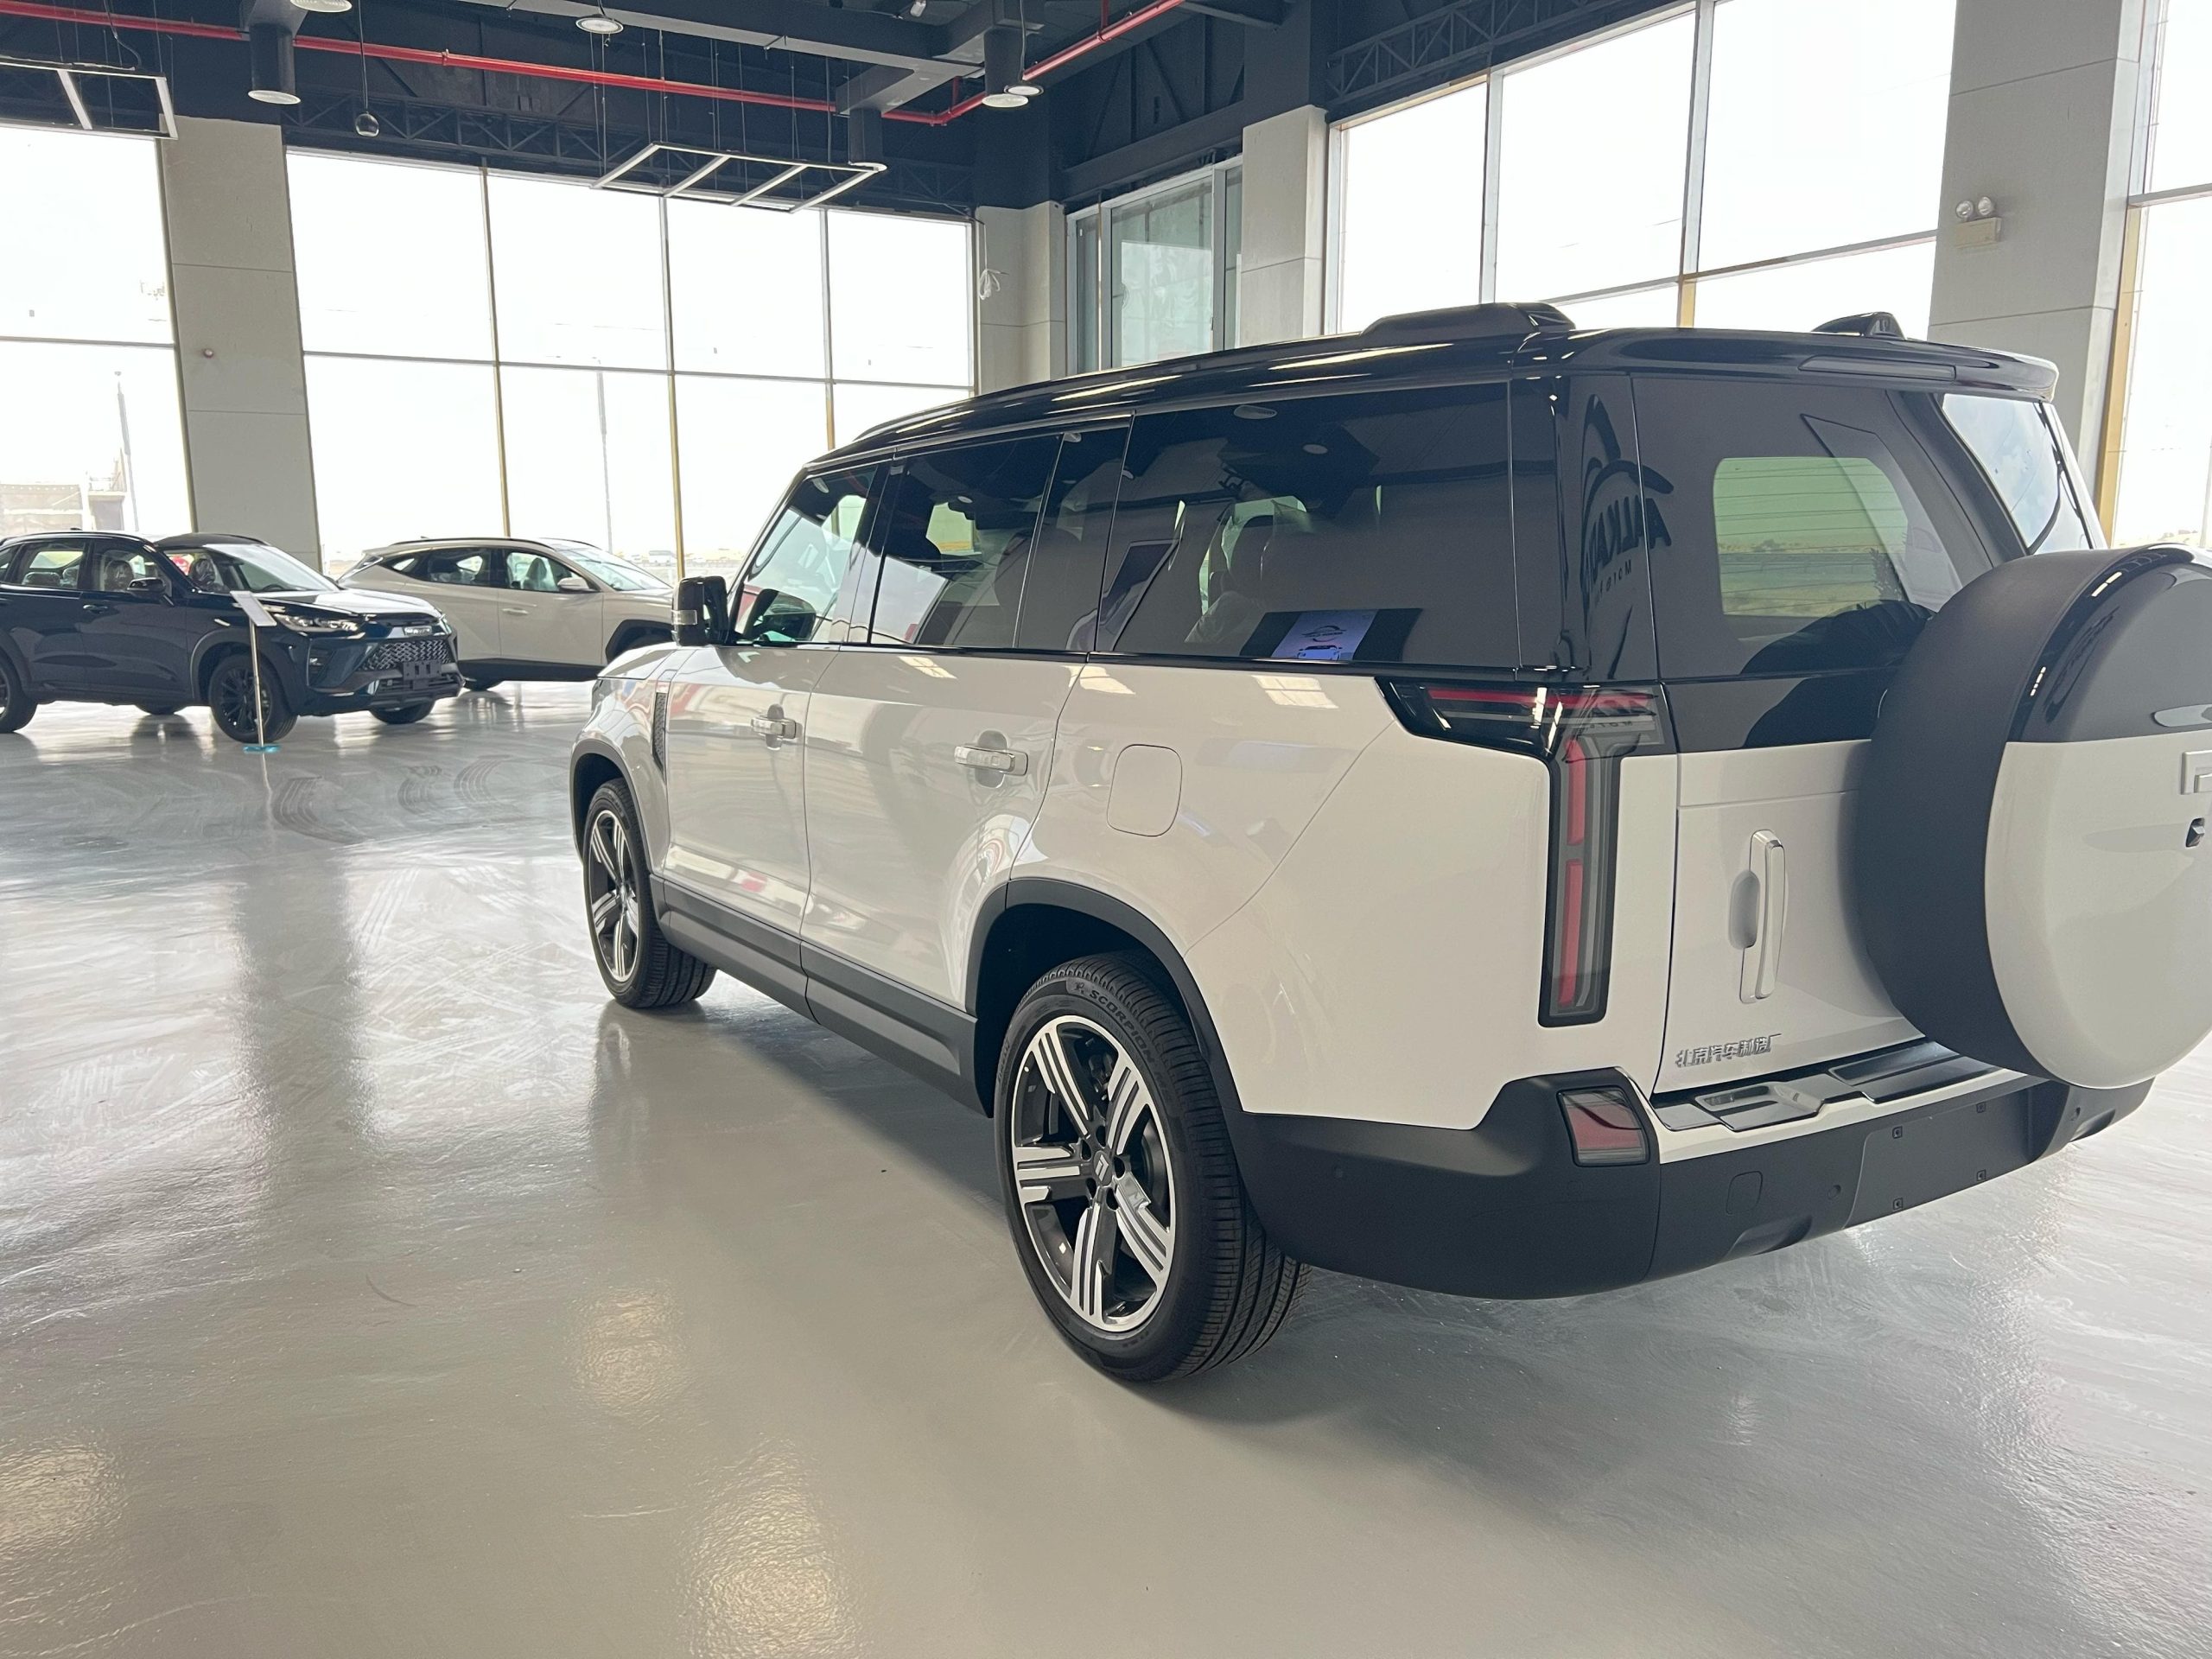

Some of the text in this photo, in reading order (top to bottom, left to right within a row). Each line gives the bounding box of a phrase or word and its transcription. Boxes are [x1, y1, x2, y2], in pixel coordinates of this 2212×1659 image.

[1089, 989, 1154, 1064] SCORPION
[1675, 1033, 1782, 1067] 北京汽车制造厂
